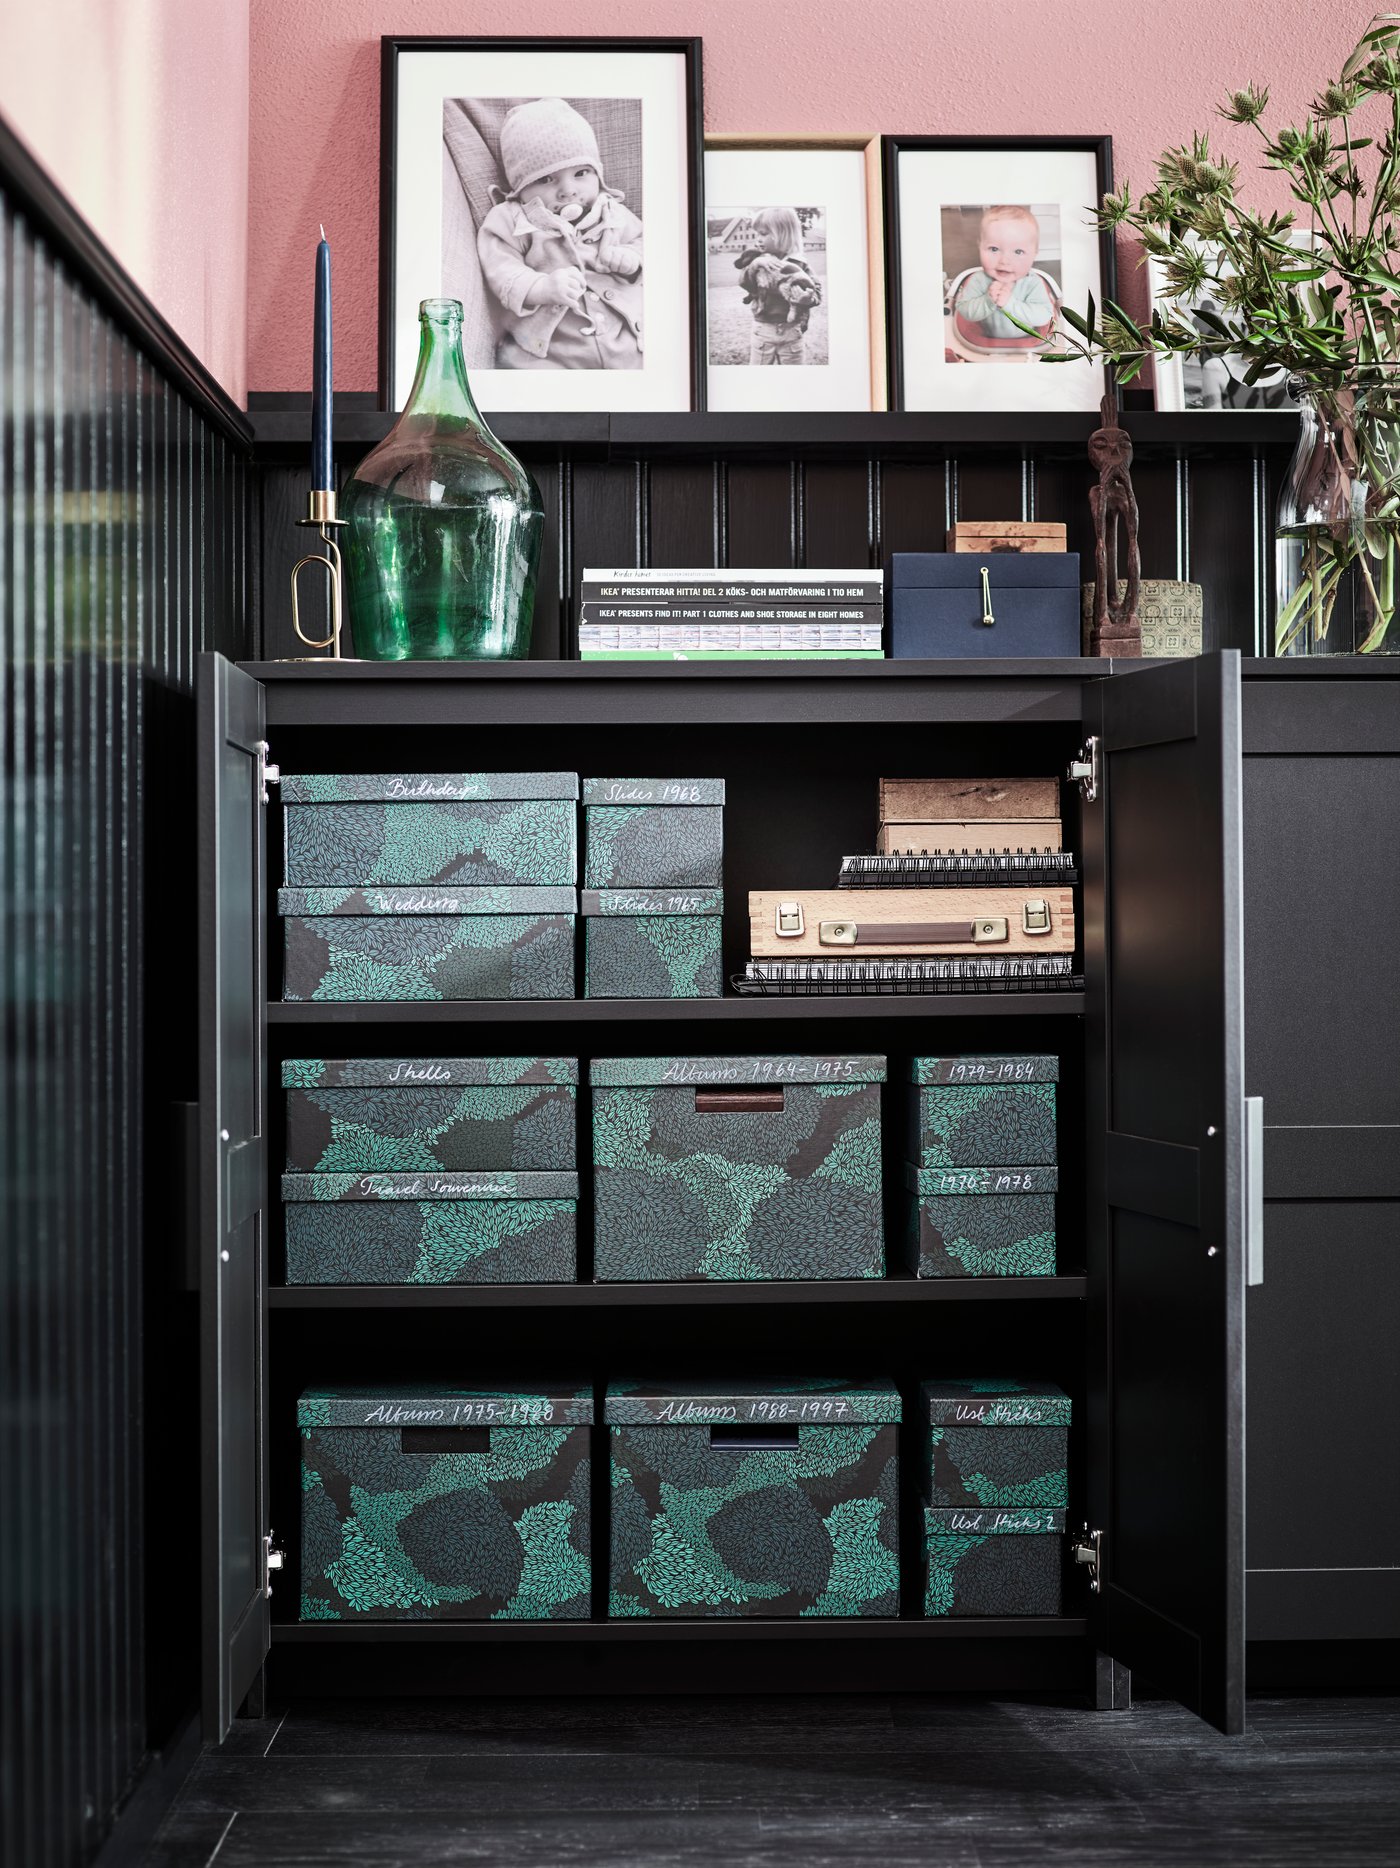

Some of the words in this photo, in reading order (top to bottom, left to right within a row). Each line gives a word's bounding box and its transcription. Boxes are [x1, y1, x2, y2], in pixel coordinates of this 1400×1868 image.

[621, 588, 675, 596] PRESENTERAR
[676, 588, 701, 596] HITTA!
[702, 588, 717, 596] DEL
[718, 588, 724, 596] 2
[725, 587, 749, 596] KÖKS-
[750, 588, 767, 596] OCH
[768, 587, 826, 597] MATFÖRVARING
[832, 588, 845, 597] TIO
[846, 588, 864, 597] HEM
[618, 610, 654, 618] PRESENTS
[655, 610, 671, 618] FIND
[672, 610, 682, 618] IT!
[682, 610, 701, 618] PART
[702, 610, 707, 618] 1
[708, 610, 739, 619] CLOTHES
[740, 610, 755, 619] AND
[756, 610, 775, 619] SHOE
[776, 610, 807, 619] STORAGE
[808, 610, 817, 619] IN
[817, 610, 838, 619] EIGHT
[839, 610, 864, 619] HOMES
[604, 783, 653, 801] Slides
[662, 785, 701, 801] 1968
[666, 896, 701, 912] 1965
[388, 1063, 452, 1081] Shells
[661, 1061, 738, 1082] Albums
[949, 1062, 1035, 1080] 1979-1984
[360, 1175, 421, 1196] Travel
[364, 1404, 445, 1424] Albums
[656, 1400, 737, 1421] Albums
[749, 1401, 850, 1419] 1988-1997
[1045, 1515, 1058, 1530] 2
